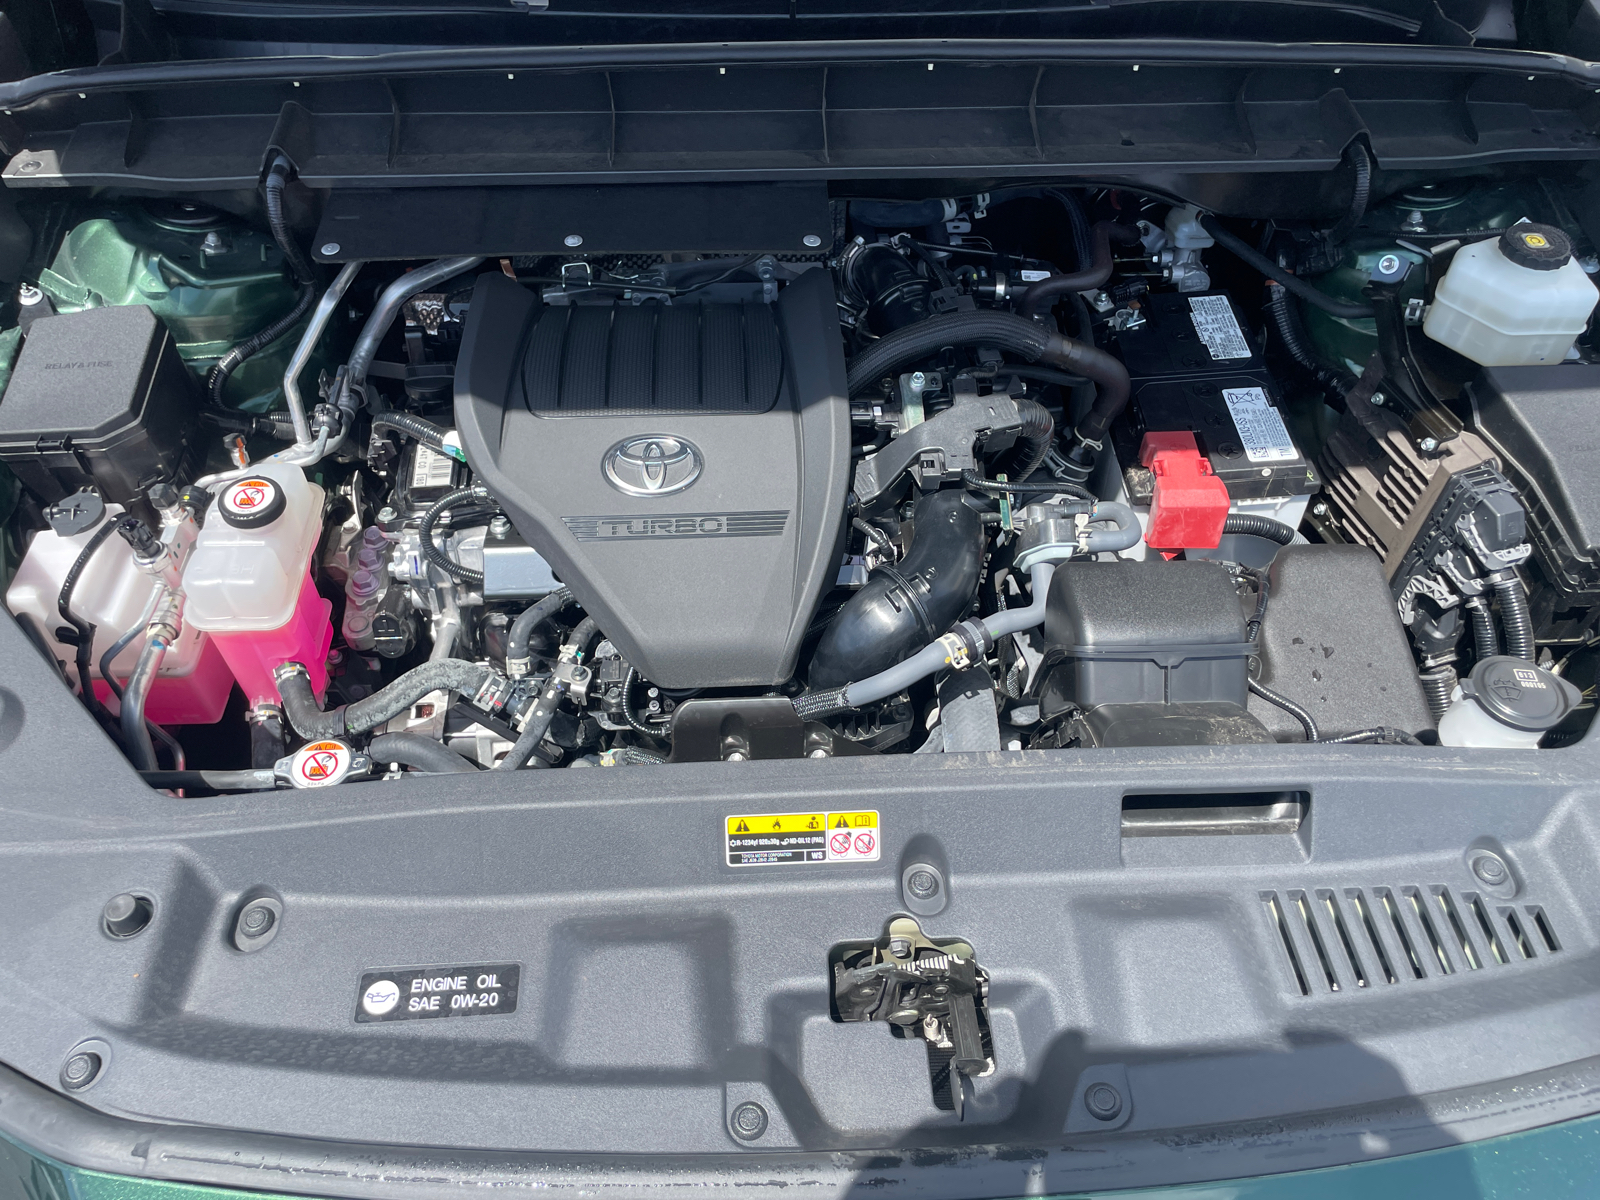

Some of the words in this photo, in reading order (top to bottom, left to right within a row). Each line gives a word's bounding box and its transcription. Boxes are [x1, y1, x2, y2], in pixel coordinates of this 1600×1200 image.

[44, 362, 77, 370] RELAY
[87, 360, 113, 368] FUSE
[602, 518, 723, 535] TURBO
[811, 851, 823, 860] WS
[411, 976, 468, 993] ENGINE
[476, 974, 502, 989] OIL
[408, 995, 441, 1012] SAE
[451, 992, 499, 1009] 0W-20
